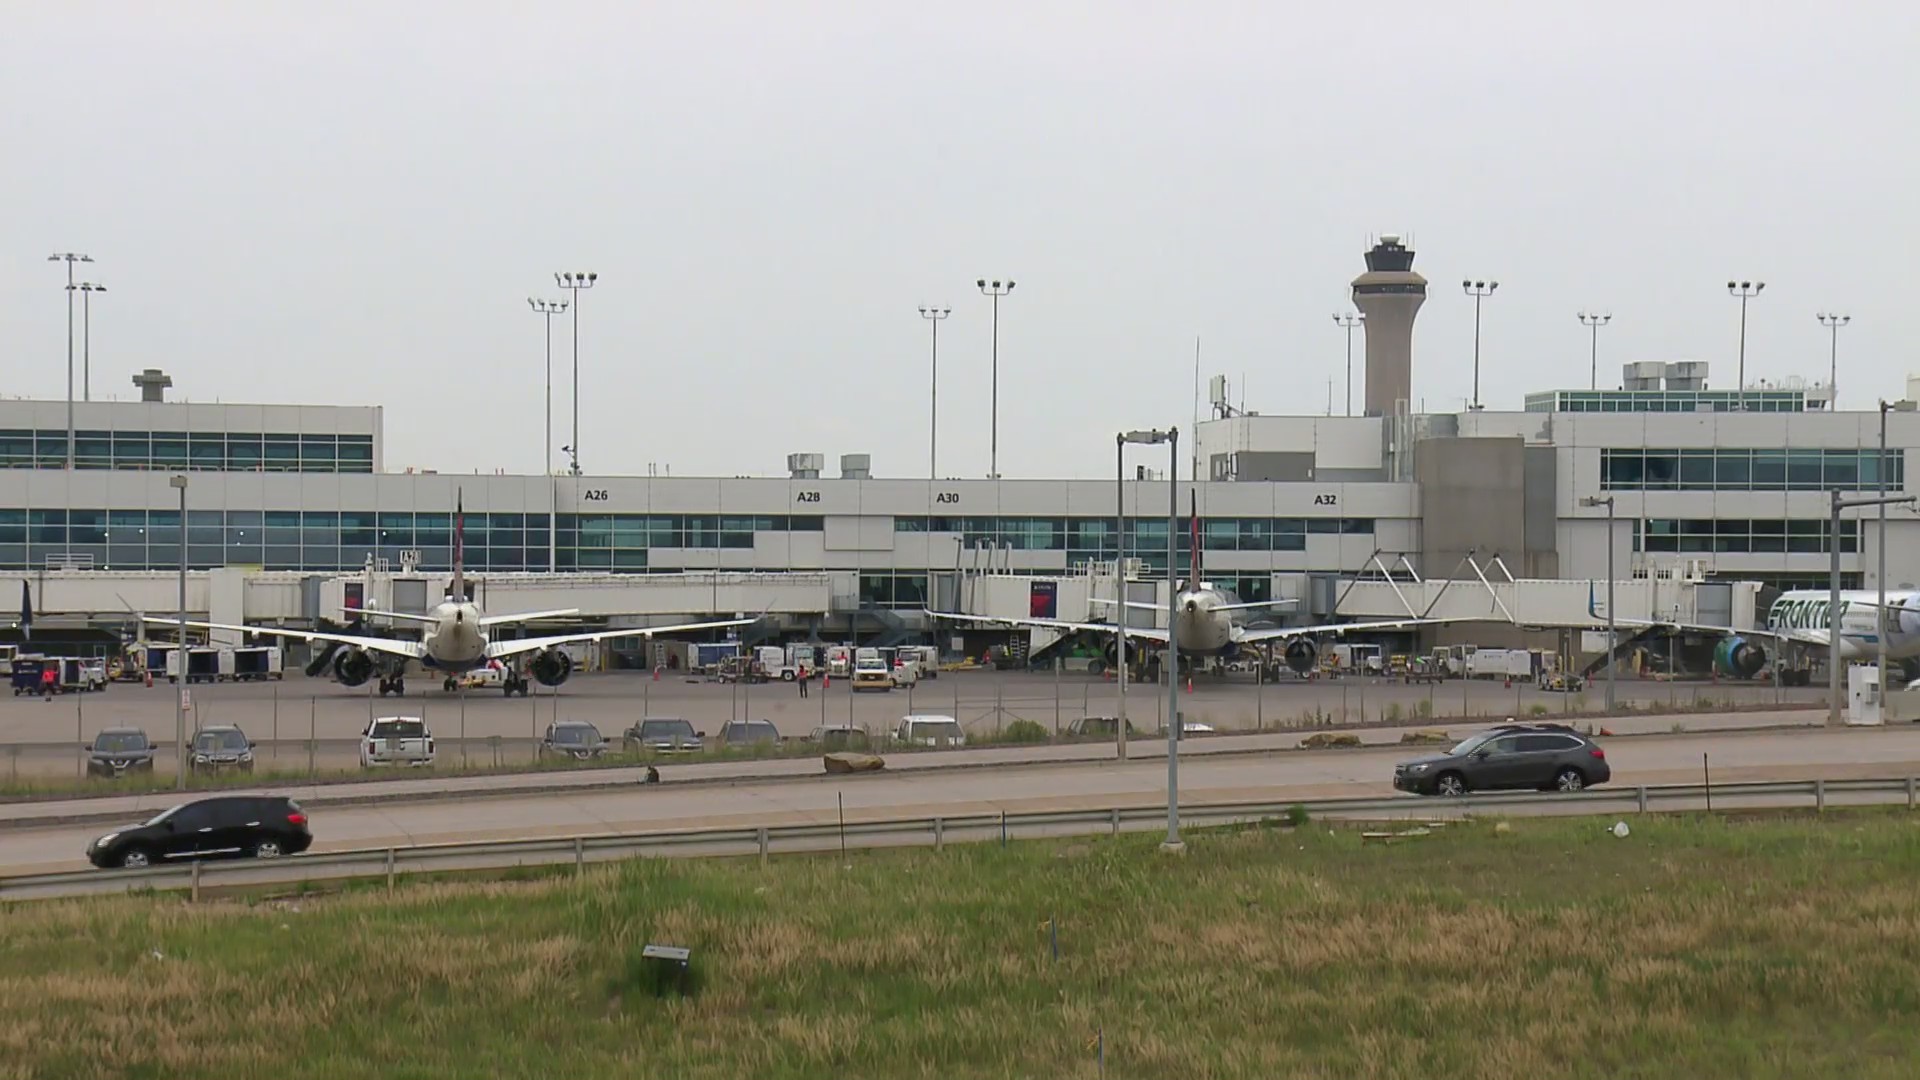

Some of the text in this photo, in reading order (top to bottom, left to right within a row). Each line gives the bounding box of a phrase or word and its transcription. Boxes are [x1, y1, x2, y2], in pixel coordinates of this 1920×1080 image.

[584, 489, 608, 501] A26
[796, 491, 820, 502] A28
[936, 492, 960, 504] A30
[1314, 494, 1337, 505] A32
